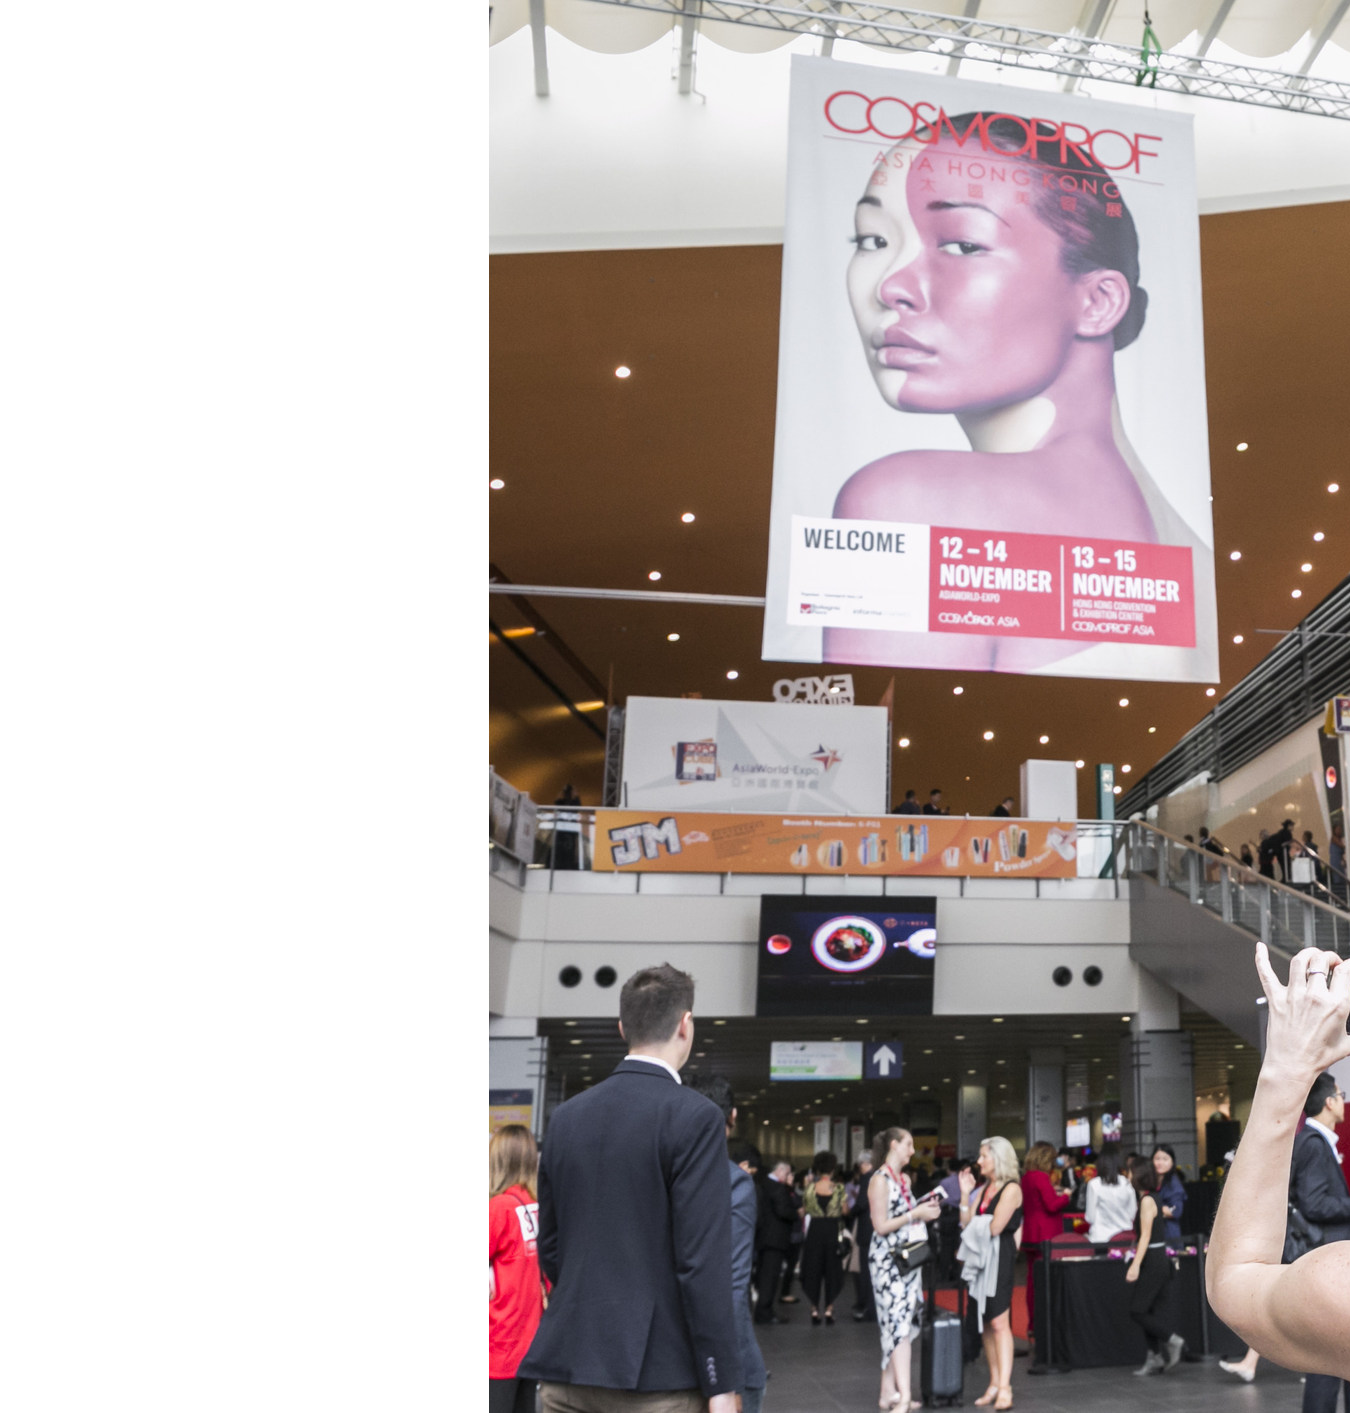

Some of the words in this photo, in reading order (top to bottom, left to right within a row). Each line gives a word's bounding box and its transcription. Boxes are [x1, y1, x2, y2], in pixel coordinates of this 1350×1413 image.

[824, 90, 1163, 174] COSMOPROF
[872, 151, 935, 173] ASIA
[947, 159, 1031, 186] HONG
[1042, 173, 1121, 199] KONG
[804, 527, 906, 553] WELCOME
[940, 536, 963, 559] 12
[984, 539, 1008, 562] 14
[1072, 546, 1094, 569] 13
[1114, 549, 1137, 572] 15
[940, 563, 1052, 593] NOVEMBER
[1072, 572, 1180, 602] NOVEMBER
[997, 616, 1020, 627] ASIA
[1133, 625, 1155, 636] ASIA
[609, 817, 682, 866] JM
